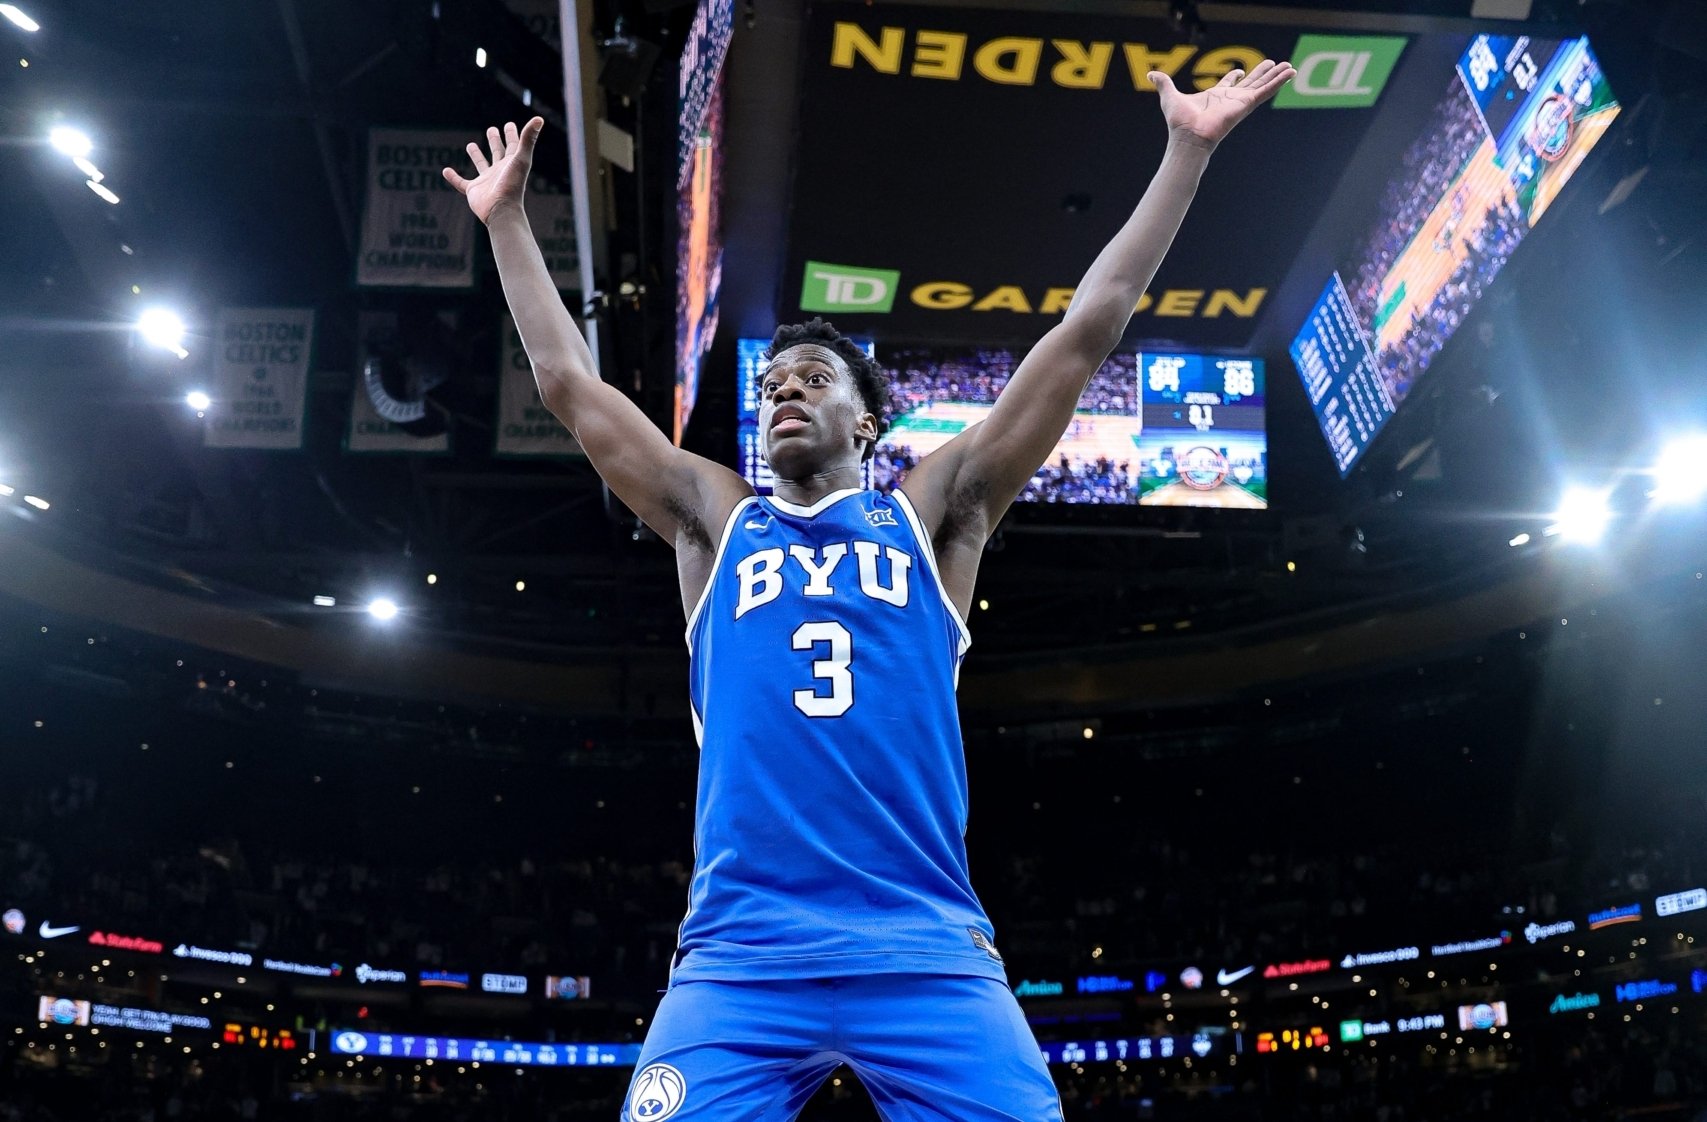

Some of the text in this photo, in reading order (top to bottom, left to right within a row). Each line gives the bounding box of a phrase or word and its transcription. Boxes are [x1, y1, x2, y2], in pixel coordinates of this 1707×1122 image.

[830, 21, 1376, 97] TD GARDEN
[814, 270, 888, 306] TD
[734, 540, 912, 622] BYU
[791, 620, 854, 718] 3
[641, 1099, 661, 1116] Y
